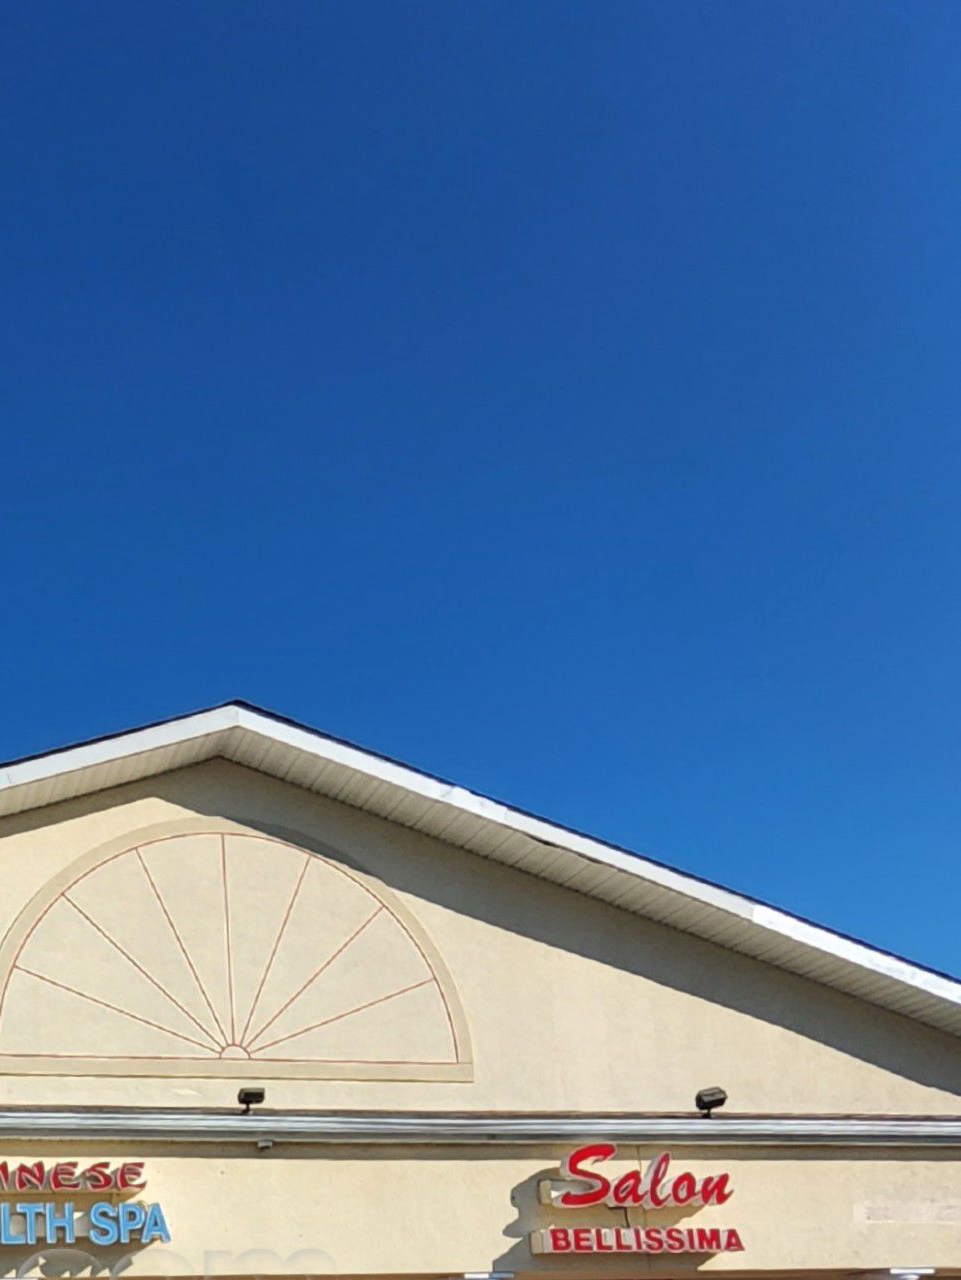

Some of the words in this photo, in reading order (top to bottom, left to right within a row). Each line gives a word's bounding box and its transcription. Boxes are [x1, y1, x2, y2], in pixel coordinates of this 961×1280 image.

[560, 1143, 735, 1207] Salon
[89, 1202, 172, 1245] SPA
[550, 1227, 746, 1253] BELLISSIMA
